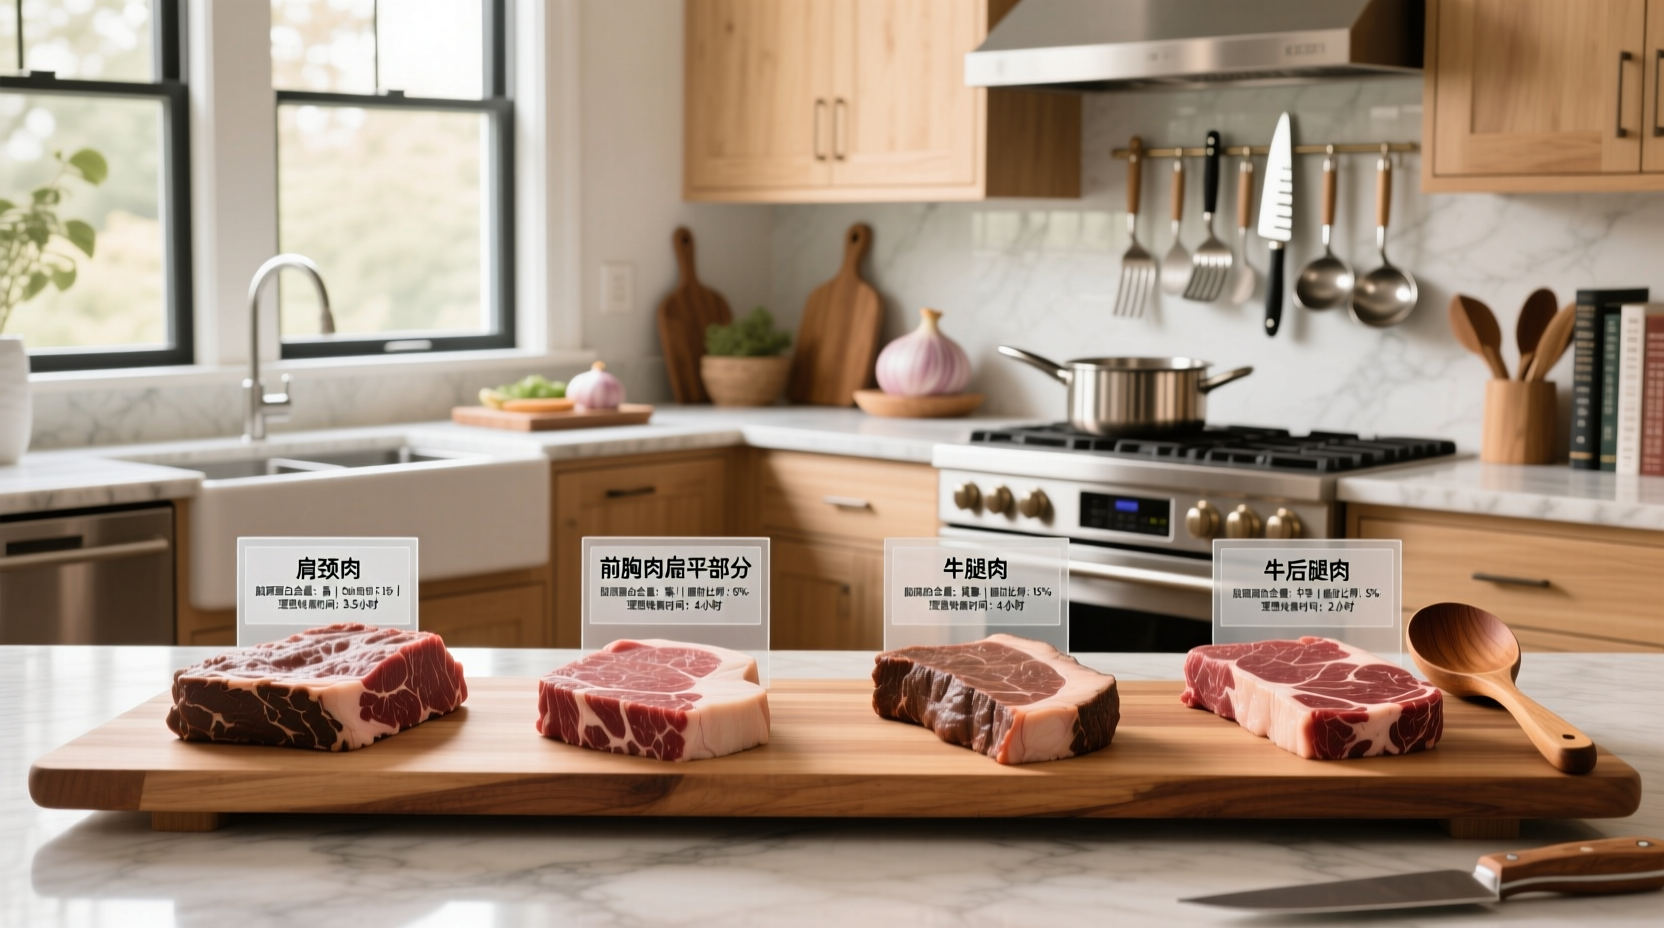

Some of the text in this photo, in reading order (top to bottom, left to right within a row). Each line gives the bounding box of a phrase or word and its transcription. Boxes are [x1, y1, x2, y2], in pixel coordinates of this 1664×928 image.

[296, 556, 361, 580] 肩颈肉
[943, 556, 1008, 580] 牛腿肉
[1264, 558, 1350, 582] 牛后腿肉
